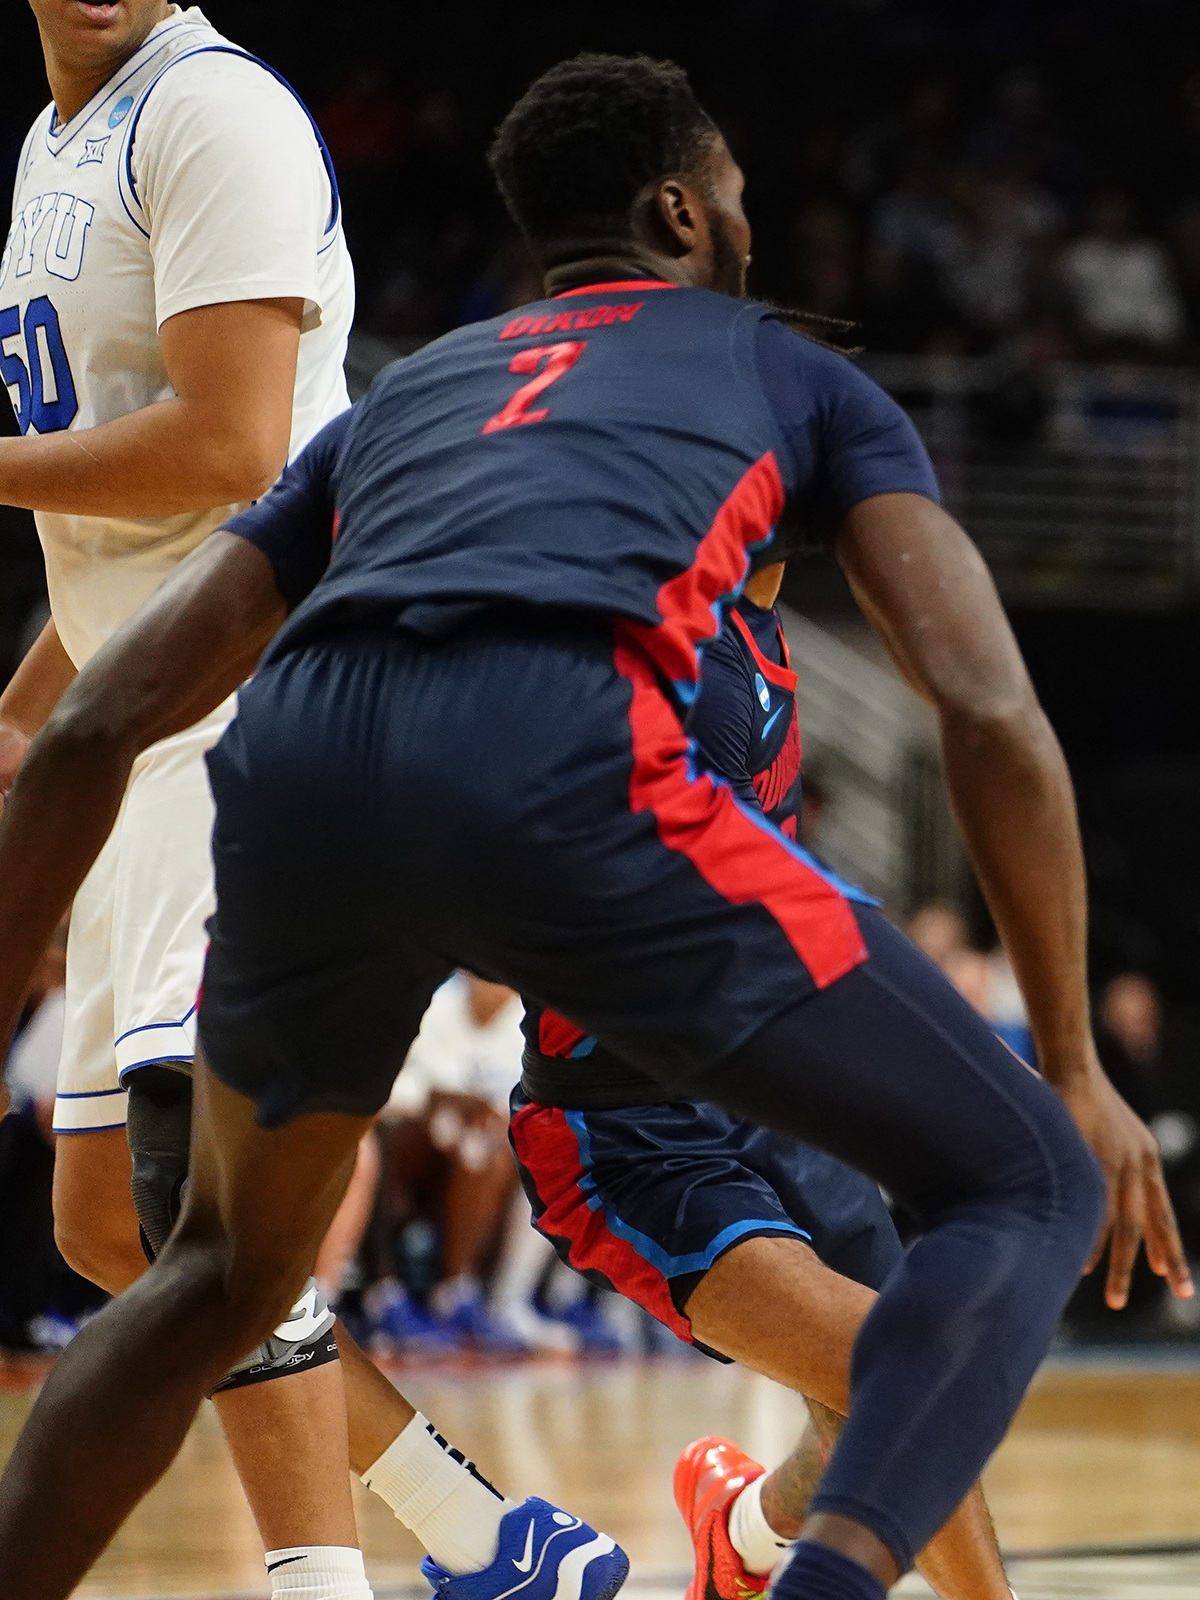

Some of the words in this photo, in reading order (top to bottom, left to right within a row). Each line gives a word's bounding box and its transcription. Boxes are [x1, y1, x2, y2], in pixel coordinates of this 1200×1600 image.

[0, 294, 79, 437] 50
[498, 302, 646, 341] DIXON
[481, 340, 588, 435] 2
